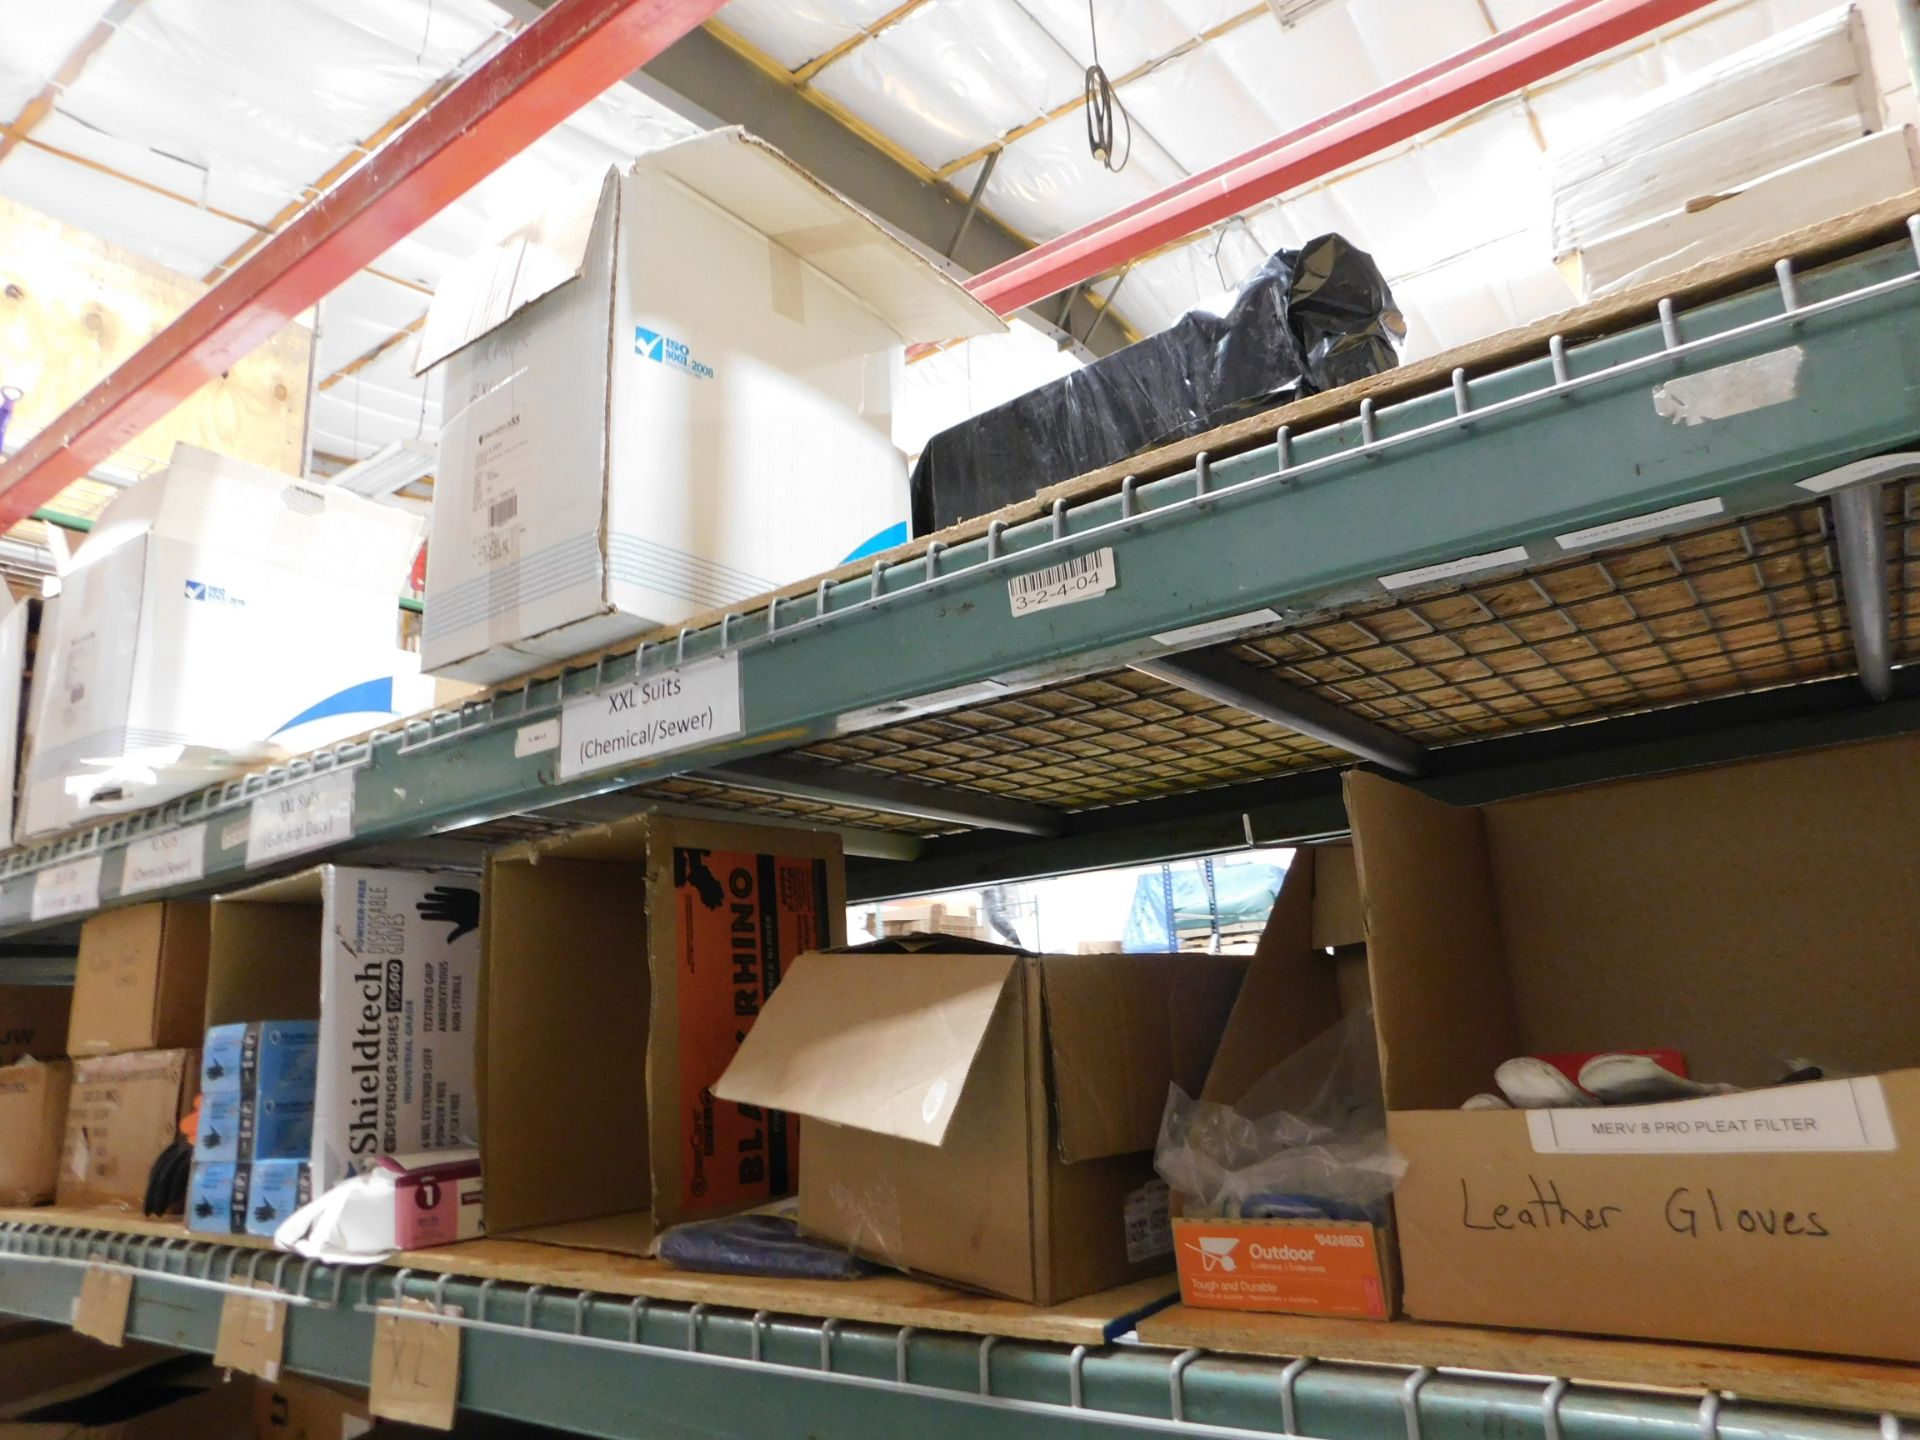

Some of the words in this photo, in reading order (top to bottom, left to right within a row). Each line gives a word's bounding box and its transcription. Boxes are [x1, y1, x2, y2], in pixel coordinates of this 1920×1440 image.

[665, 338, 690, 356] ISO
[1015, 571, 1100, 610] 3-2-4-04
[608, 688, 636, 715] XXL
[641, 677, 682, 706] Suits
[579, 705, 714, 765] (Chemical/Sewer)
[356, 879, 367, 953] POWDER-FREE
[367, 886, 388, 954] DISPOSABLE
[387, 913, 406, 954] GLOVES
[729, 868, 761, 1016] RHINO
[425, 962, 435, 984] GRIP
[405, 1000, 414, 1037] GRADE
[423, 986, 434, 1033] TEXTURED
[438, 961, 449, 1033] AMBIDEXTROUS
[350, 960, 383, 1155] Shieldtech
[387, 1014, 400, 1062] SERIES
[403, 1039, 413, 1104] INDUSTRIAL
[384, 1066, 398, 1136] DEFENDER
[421, 1072, 432, 1121] EXTENDED
[1591, 1122, 1640, 1137] MERV
[1641, 1121, 1651, 1135] 8
[1654, 1120, 1690, 1135] PRO
[1694, 1118, 1749, 1135] PLEAT
[1754, 1117, 1817, 1133] FILTER
[422, 1184, 434, 1207] 1
[1460, 1174, 1621, 1232] Leather
[1664, 1186, 1830, 1238] Gloves
[1249, 1243, 1315, 1261] Outdoor
[1191, 1278, 1219, 1292] Tough
[1221, 1279, 1239, 1291] and
[1240, 1280, 1277, 1294] Durable
